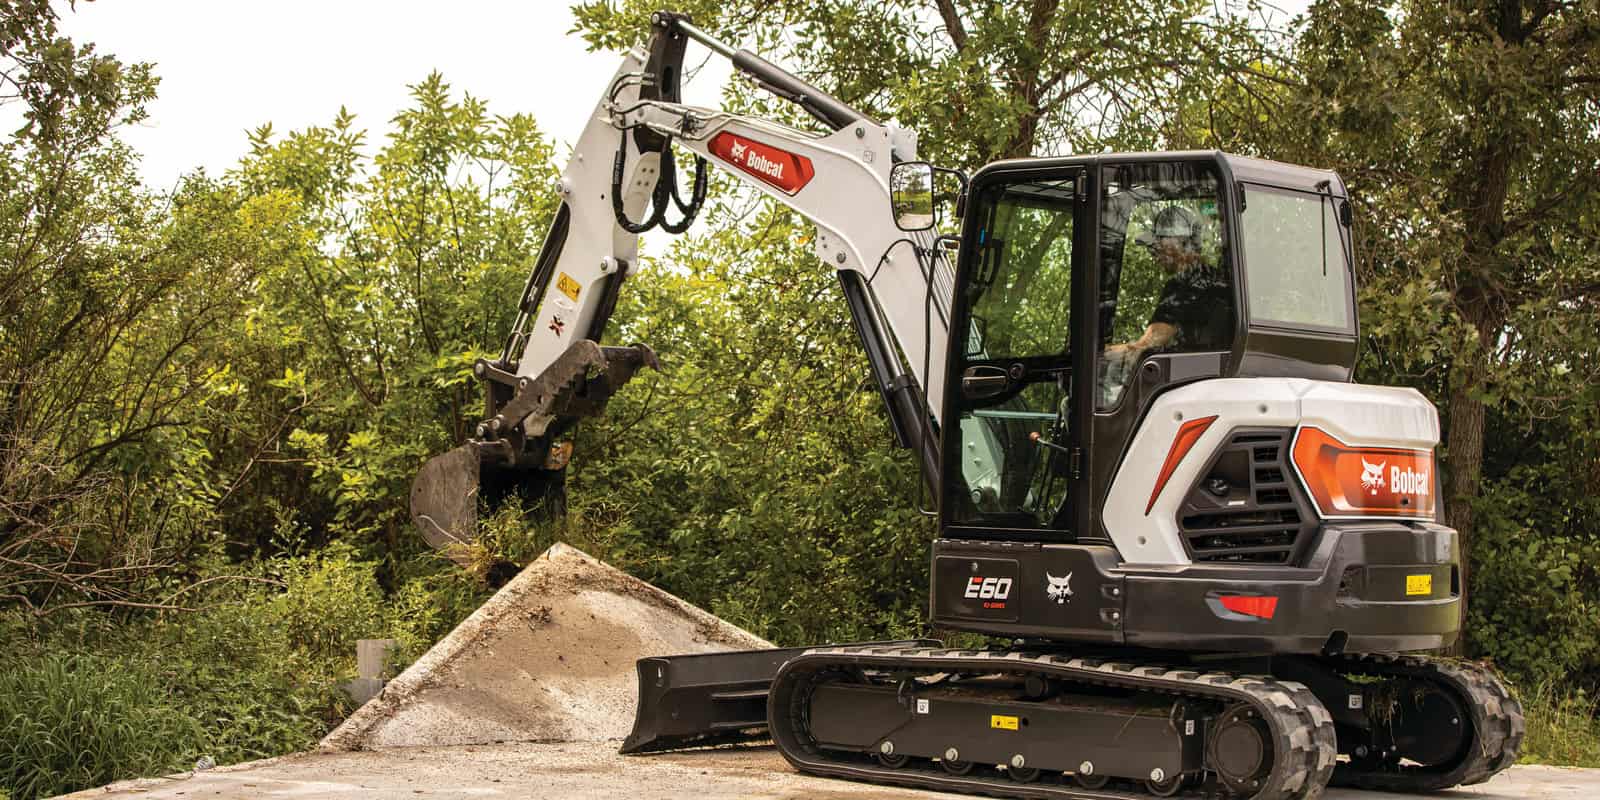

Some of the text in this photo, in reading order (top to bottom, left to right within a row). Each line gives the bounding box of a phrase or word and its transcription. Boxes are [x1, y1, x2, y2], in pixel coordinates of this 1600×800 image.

[747, 150, 784, 179] Bobcat
[1391, 465, 1429, 496] Bobcat
[964, 577, 1013, 600] E60
